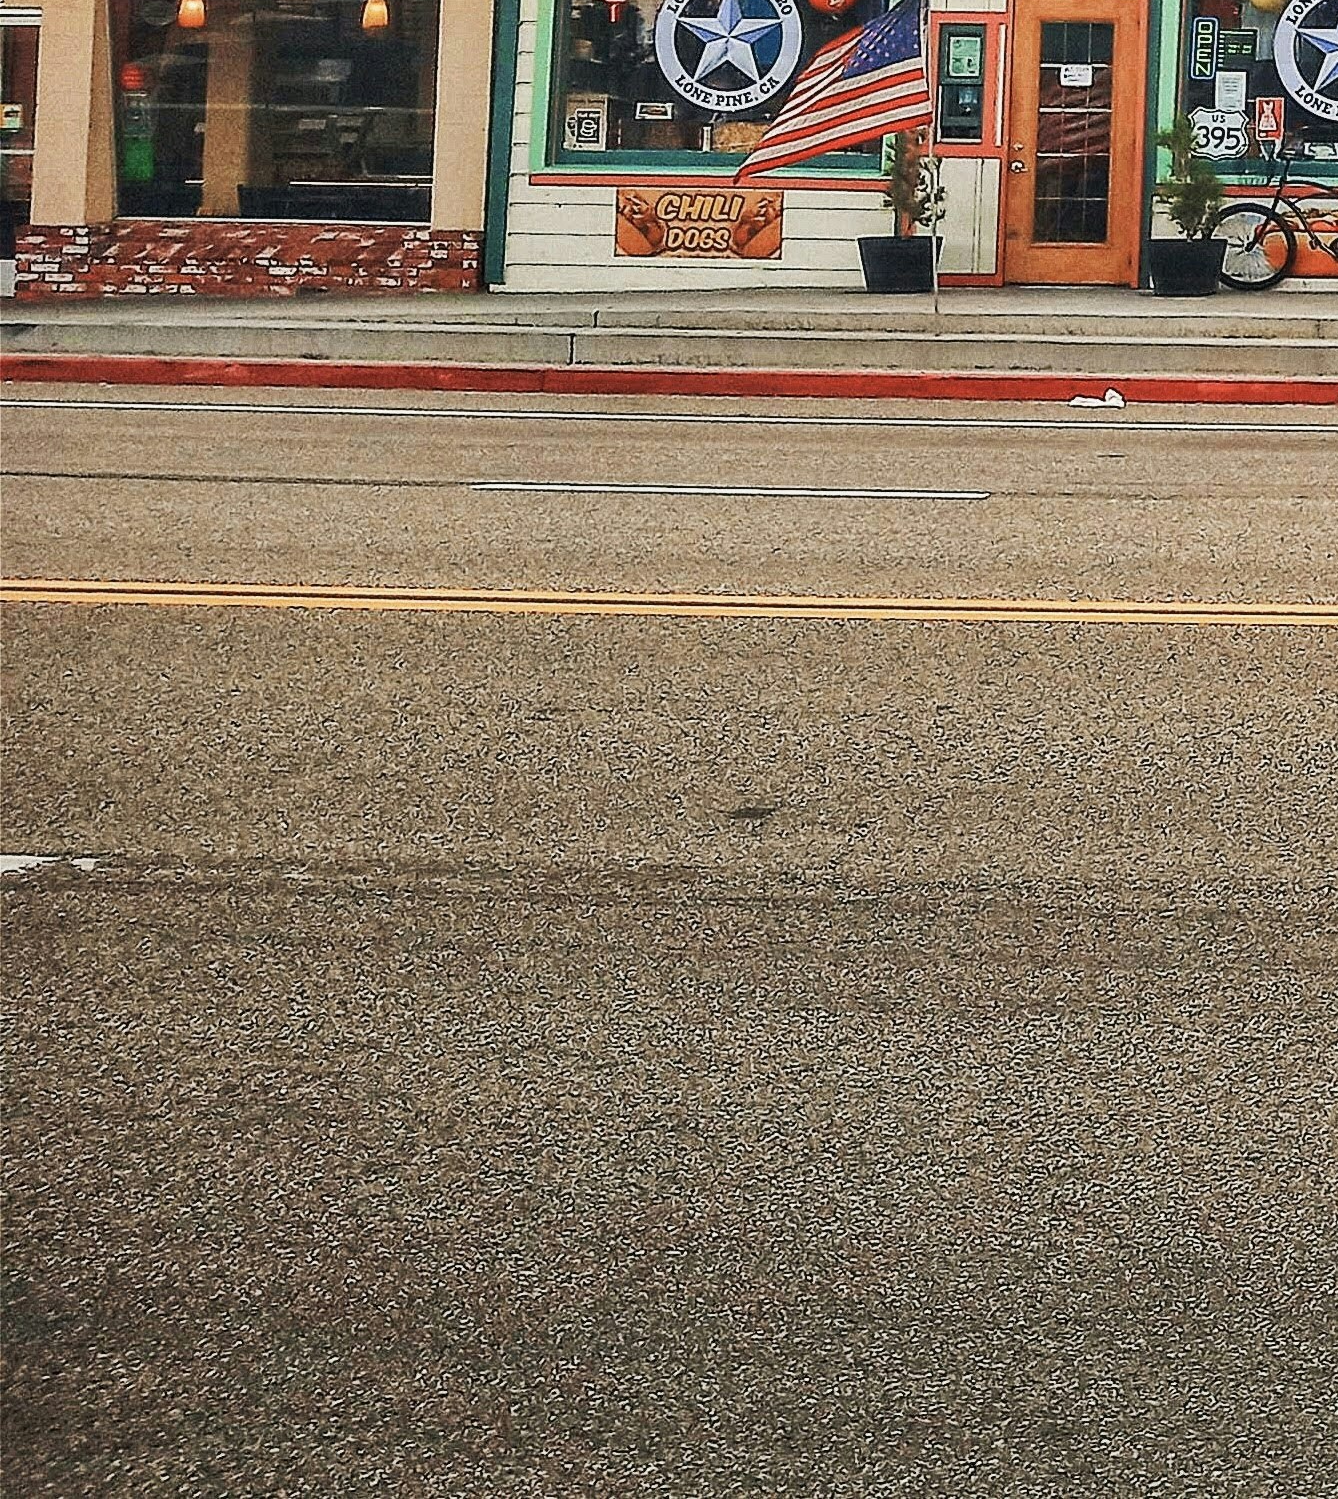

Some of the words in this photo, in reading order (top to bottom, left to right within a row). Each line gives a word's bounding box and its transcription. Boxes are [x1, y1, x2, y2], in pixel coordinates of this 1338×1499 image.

[1195, 21, 1213, 76] OPEN
[675, 74, 712, 105] LONE
[759, 76, 780, 95] CA
[1295, 85, 1332, 115] LONE
[1211, 114, 1226, 123] US
[1196, 125, 1241, 150] 395
[656, 193, 743, 222] CHILI
[666, 226, 731, 249] DOGS
